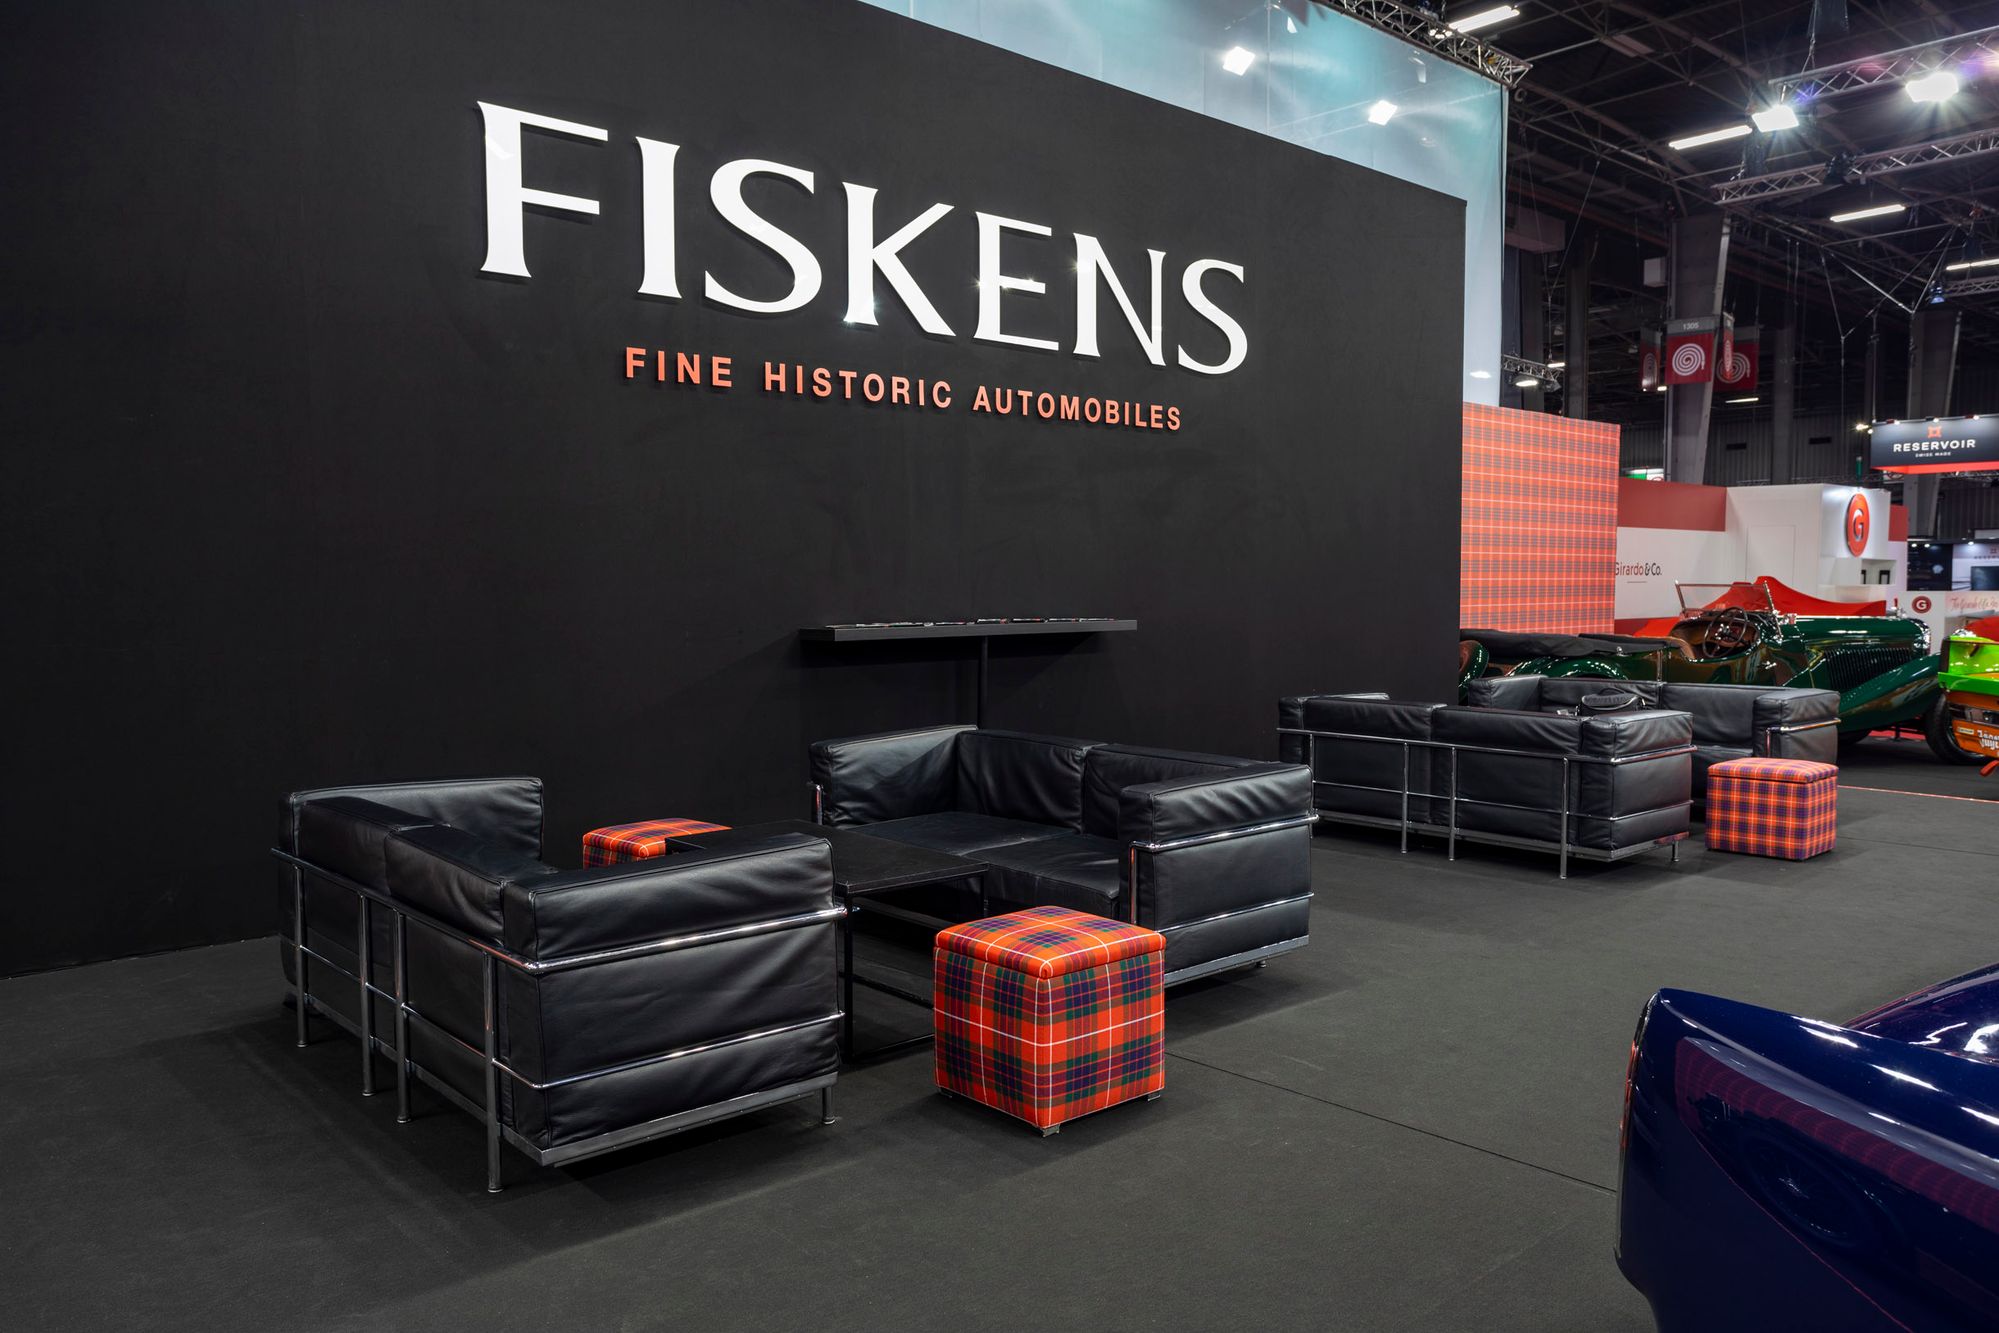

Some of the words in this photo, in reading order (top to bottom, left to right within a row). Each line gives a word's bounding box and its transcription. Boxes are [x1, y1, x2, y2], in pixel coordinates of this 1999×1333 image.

[477, 101, 1248, 375] FISKENS
[625, 347, 733, 388] FINE
[764, 361, 952, 409] HISTORIC
[973, 386, 1183, 431] AUTOMOBILES
[1893, 439, 1976, 452] RESERVOIR
